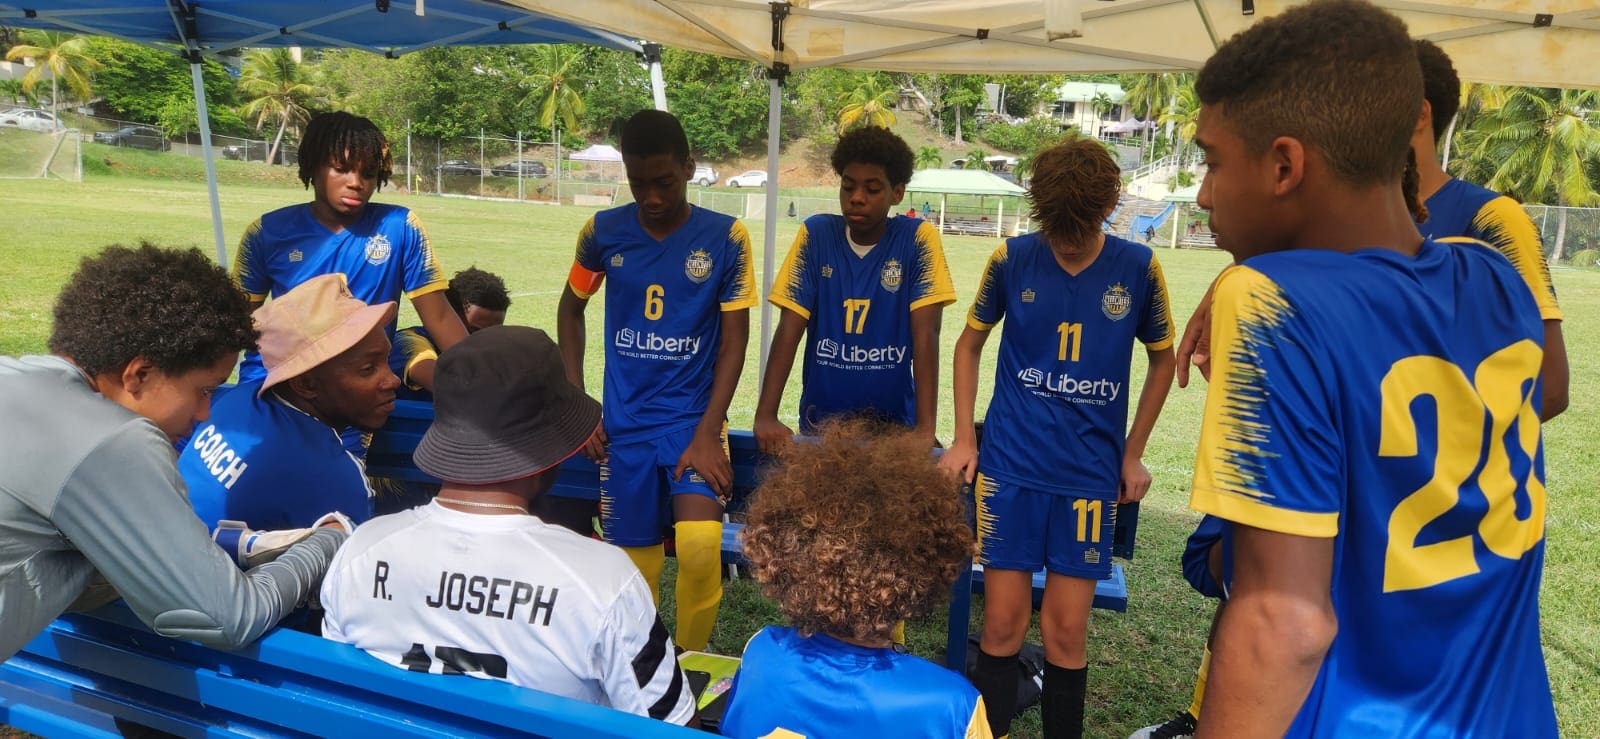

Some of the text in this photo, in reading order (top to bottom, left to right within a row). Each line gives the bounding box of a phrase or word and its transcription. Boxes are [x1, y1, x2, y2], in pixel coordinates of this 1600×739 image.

[644, 284, 665, 321] 6
[843, 298, 870, 334] 17
[636, 331, 701, 354] Liberty
[841, 343, 907, 364] Liberty
[1057, 321, 1083, 362] 11
[1046, 371, 1121, 402] Liberty
[1072, 397, 1107, 406] CONNECTED
[194, 424, 248, 490] COACH
[1378, 338, 1546, 593] 20
[1072, 498, 1102, 543] 11
[373, 560, 559, 626] R. JOSEPH
